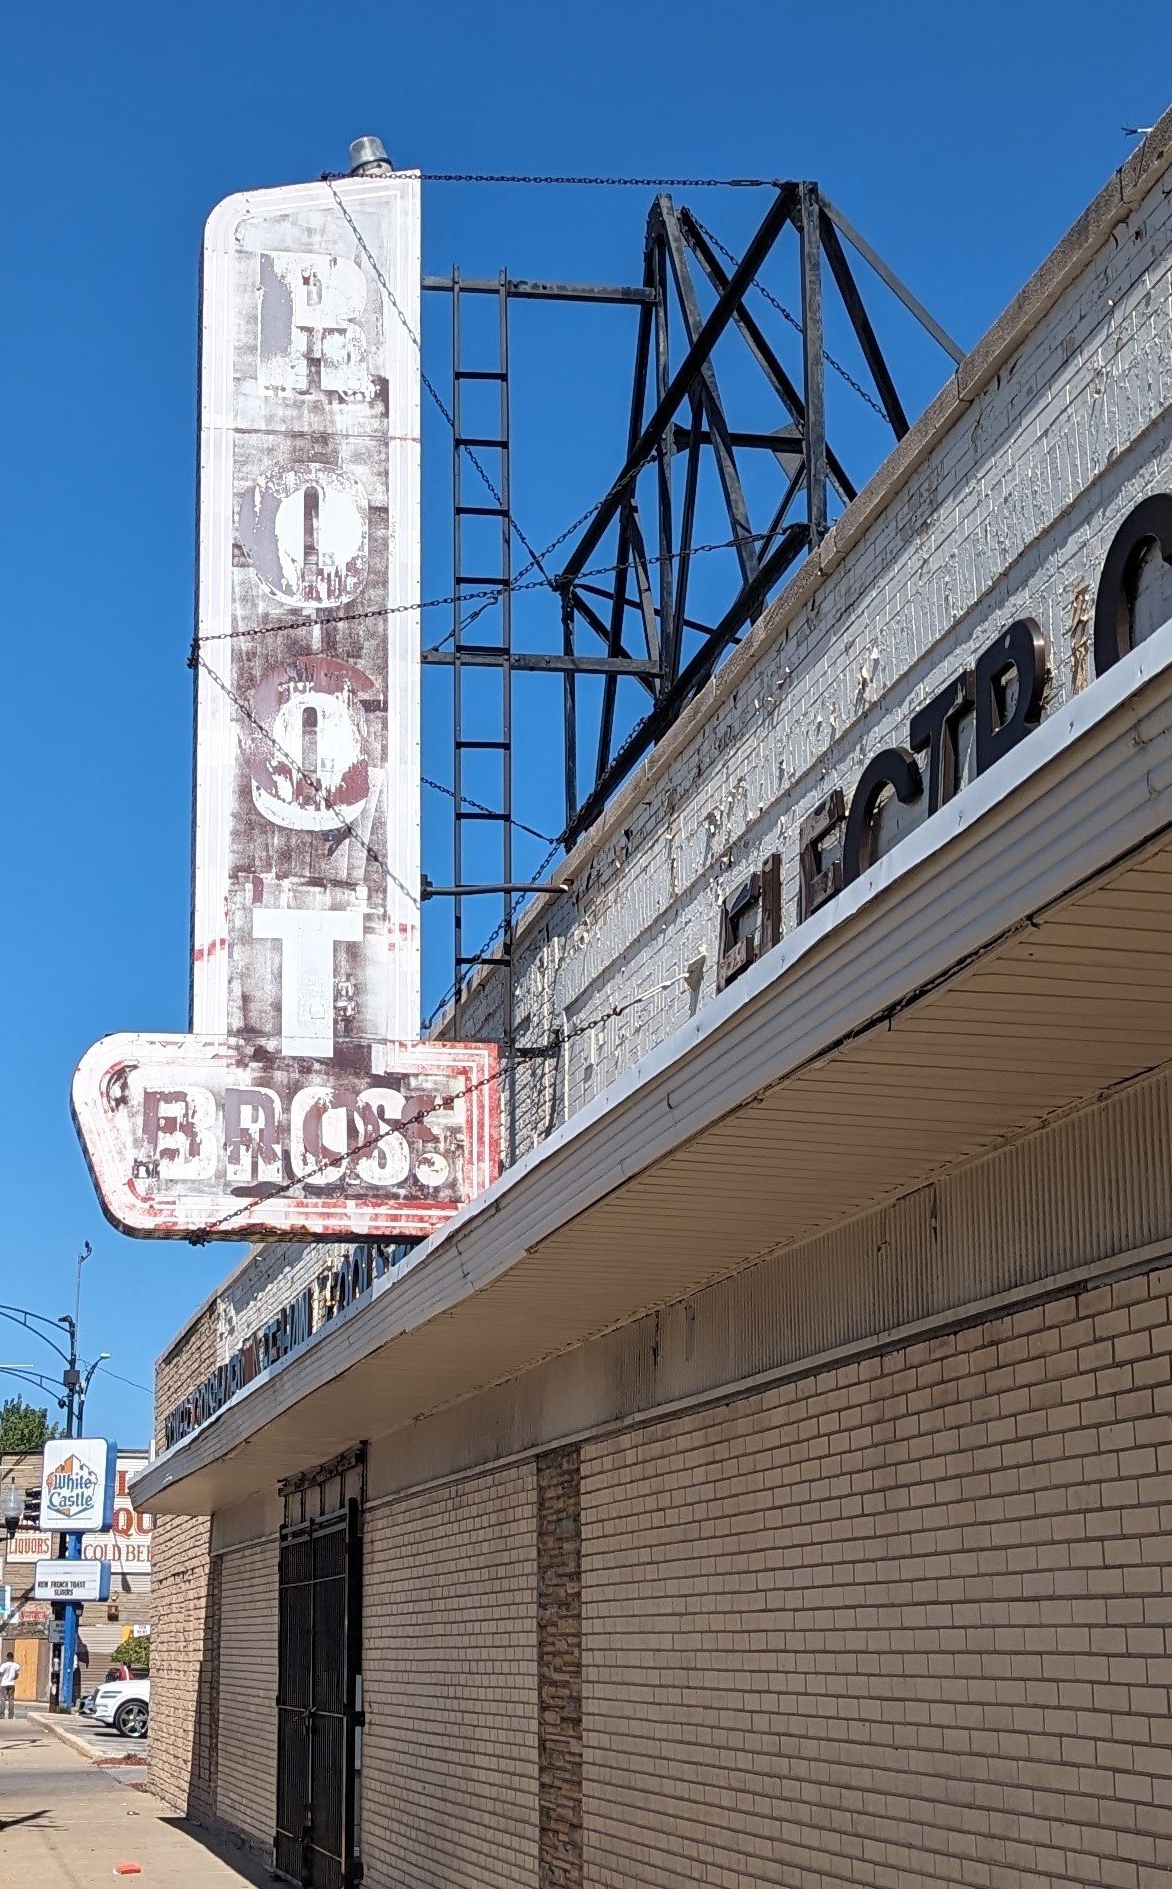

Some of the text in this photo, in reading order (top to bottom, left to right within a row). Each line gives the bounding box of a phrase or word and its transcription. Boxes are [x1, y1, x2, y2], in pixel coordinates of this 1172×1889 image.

[53, 1472, 92, 1493] White
[48, 1491, 93, 1508] Castle
[8, 1538, 50, 1555] LIQUORS
[83, 1543, 122, 1562] COLD
[50, 1580, 69, 1589] FRENCH
[70, 1580, 86, 1589] TOAST
